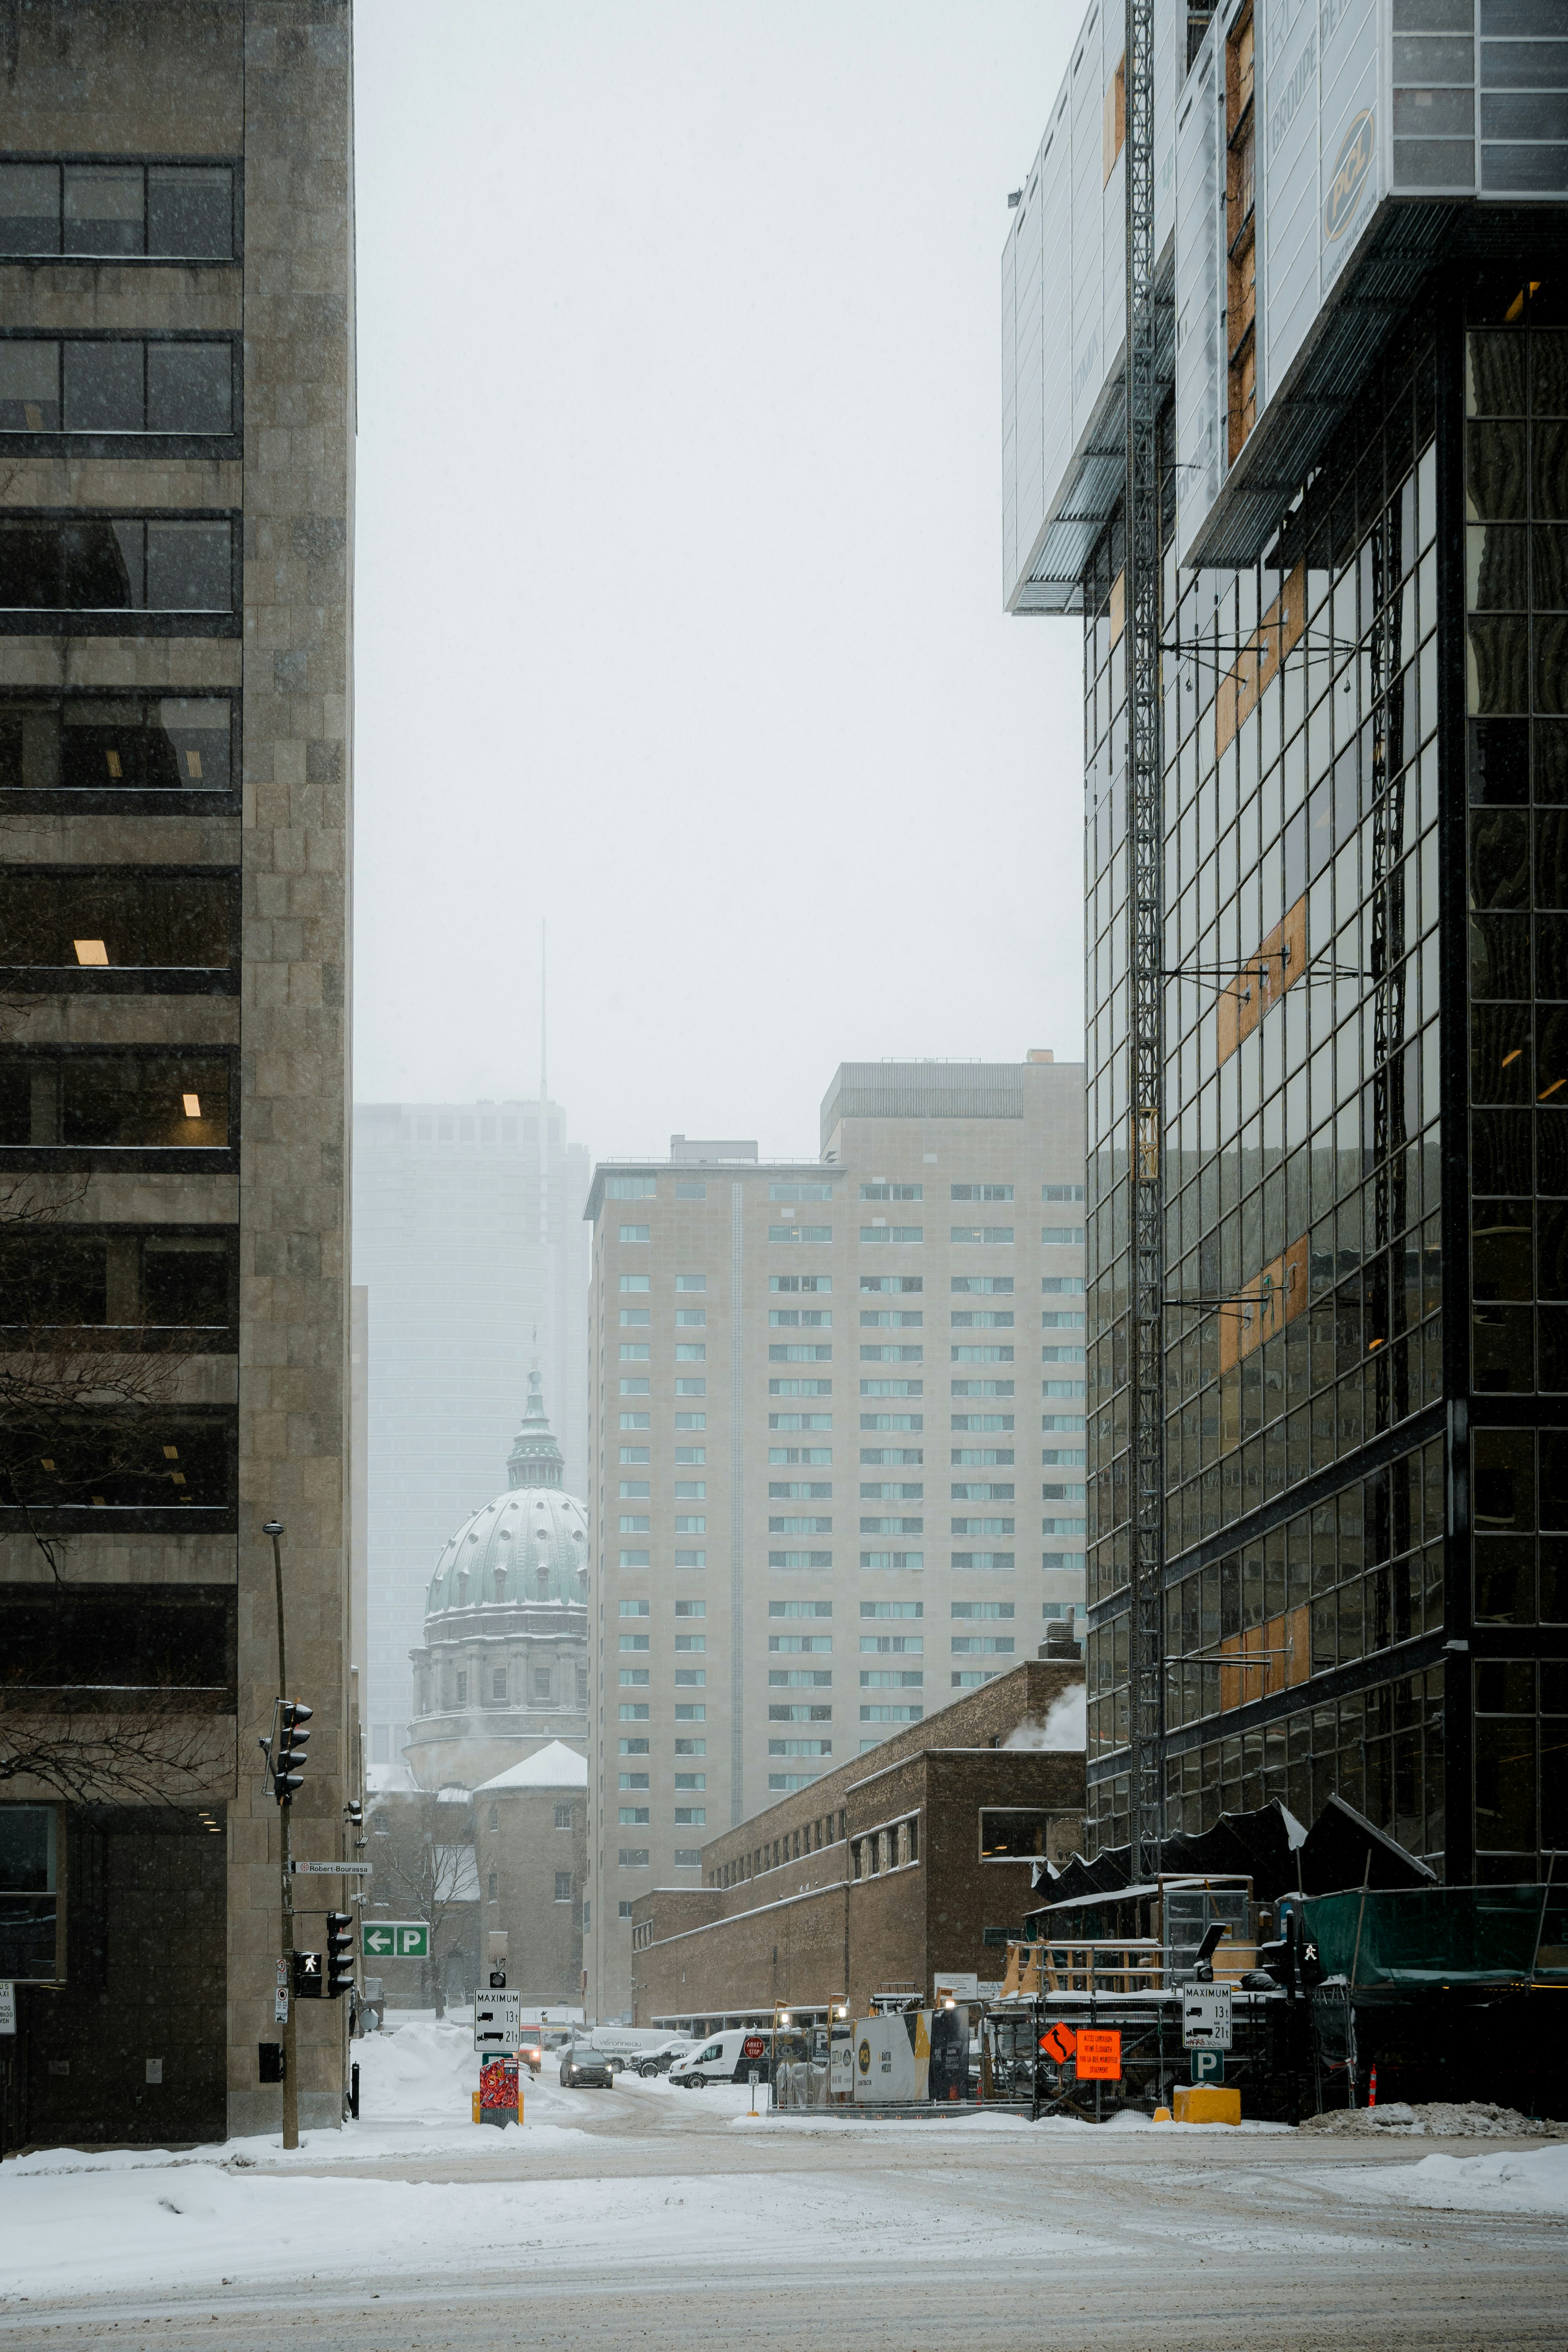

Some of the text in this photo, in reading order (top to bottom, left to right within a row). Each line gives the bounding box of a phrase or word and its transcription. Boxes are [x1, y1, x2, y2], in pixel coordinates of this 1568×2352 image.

[1272, 29, 1317, 154] GROUPE
[1332, 133, 1366, 222] PCL
[1321, 188, 1378, 294] CONSTRUCTION
[403, 1930, 421, 1953] P
[478, 1994, 518, 2002] MAXIMUM
[1186, 1988, 1229, 1998] MAXIMUM
[860, 2049, 869, 2063] PCL
[881, 2050, 891, 2061] BÂTIR
[881, 2063, 891, 2073] MIEUX
[1198, 2053, 1217, 2078] P
[751, 2076, 757, 2084] 15
